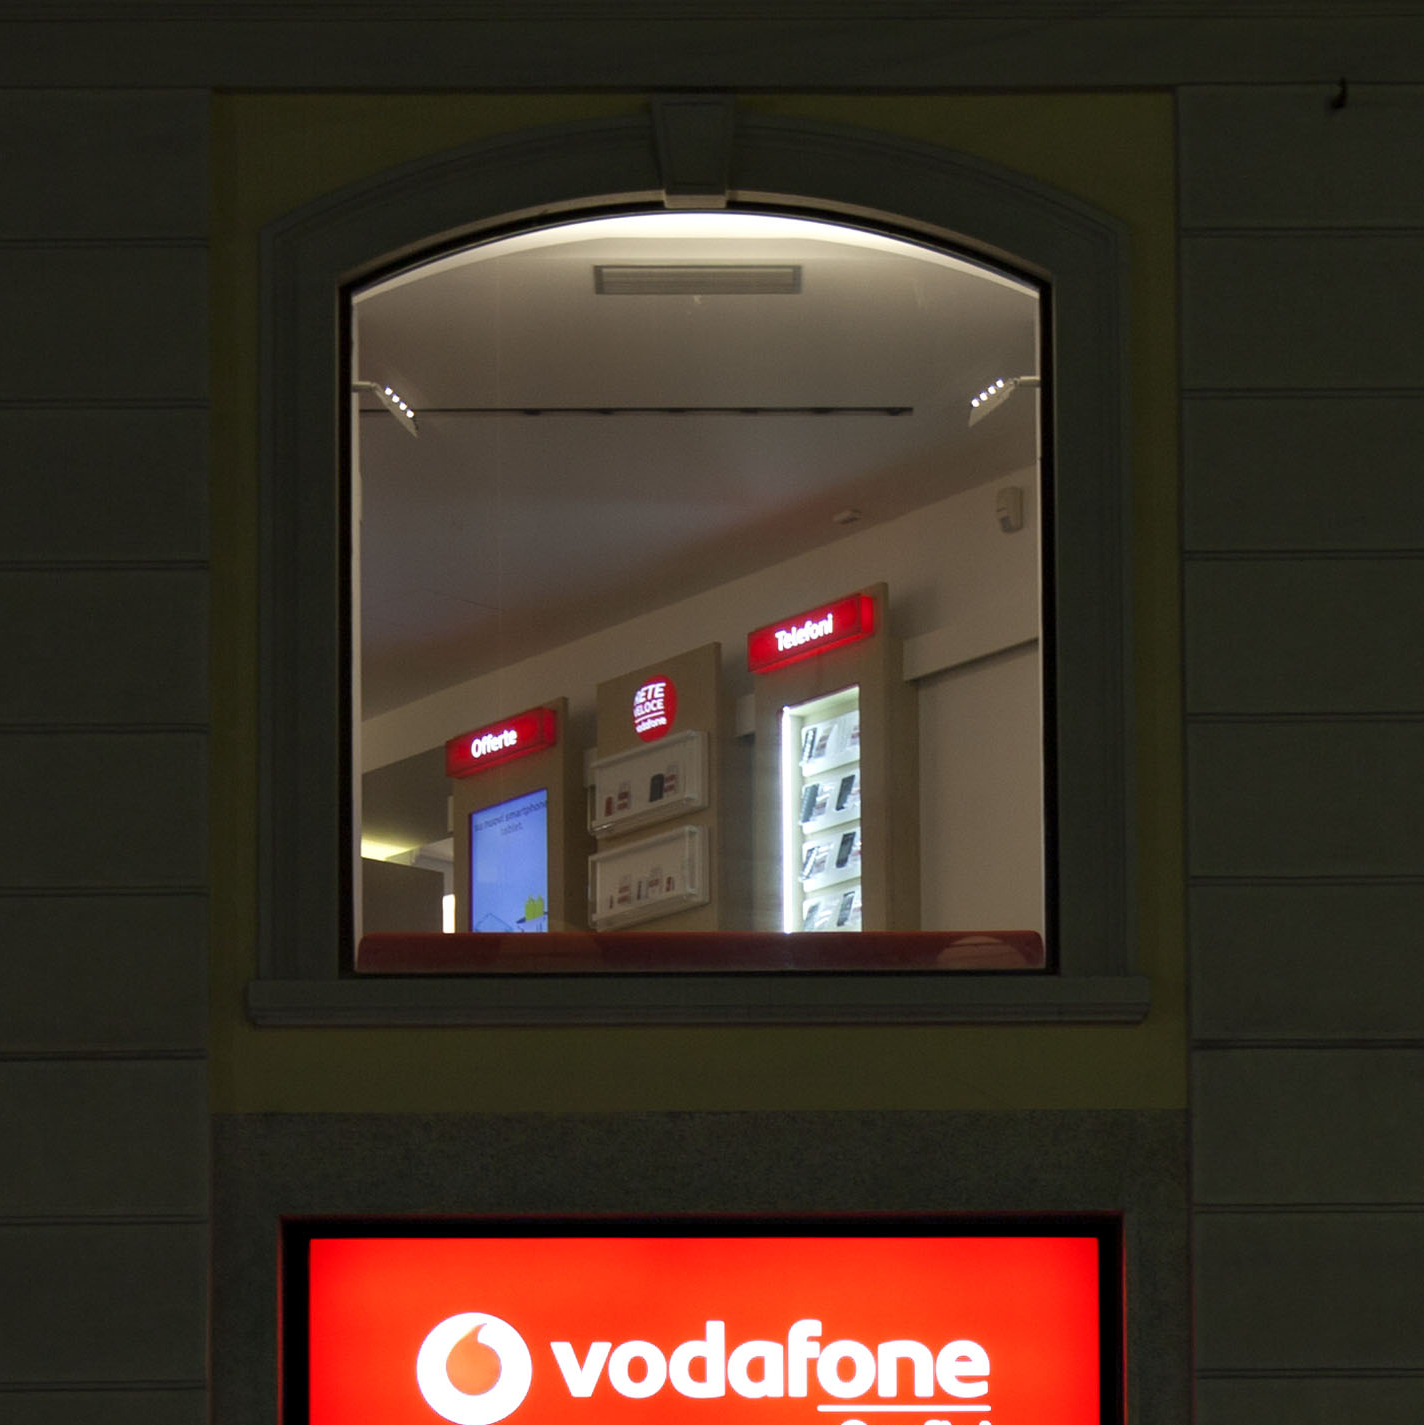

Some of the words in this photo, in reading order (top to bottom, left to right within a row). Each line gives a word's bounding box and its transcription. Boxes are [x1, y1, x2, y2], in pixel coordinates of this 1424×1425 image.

[774, 612, 834, 651] Telefoni
[471, 729, 517, 758] Offerte
[550, 1318, 991, 1399] vodafone
